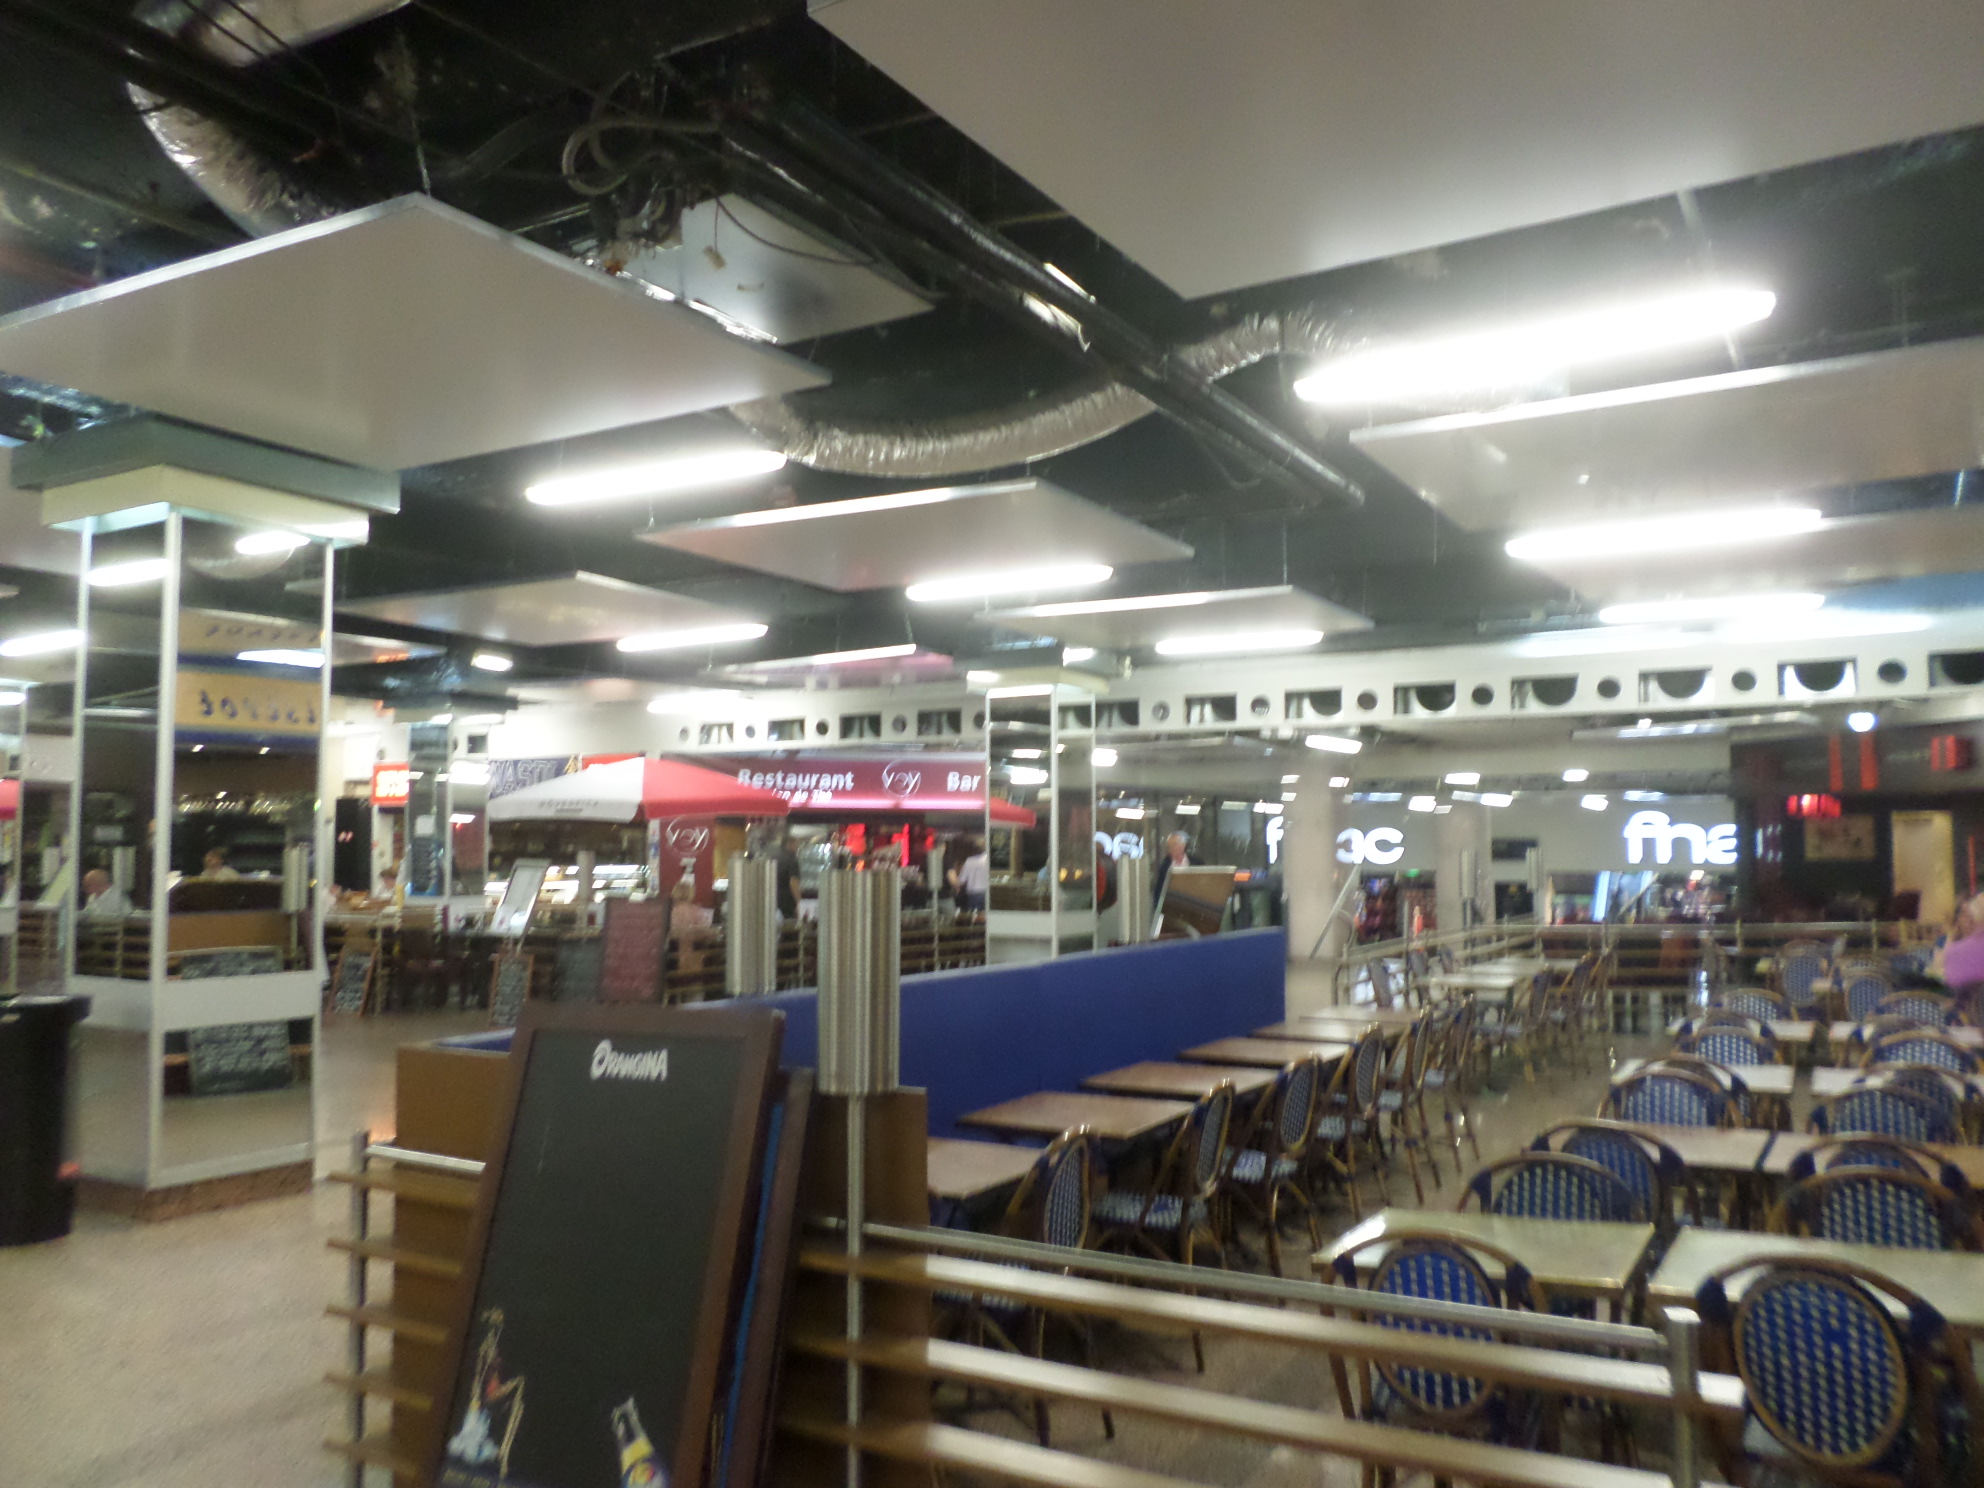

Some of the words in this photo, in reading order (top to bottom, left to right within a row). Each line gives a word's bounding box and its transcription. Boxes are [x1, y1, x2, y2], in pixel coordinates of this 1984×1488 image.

[737, 768, 854, 792] Restaurant
[946, 771, 982, 792] Bar
[1266, 816, 1405, 865] fac
